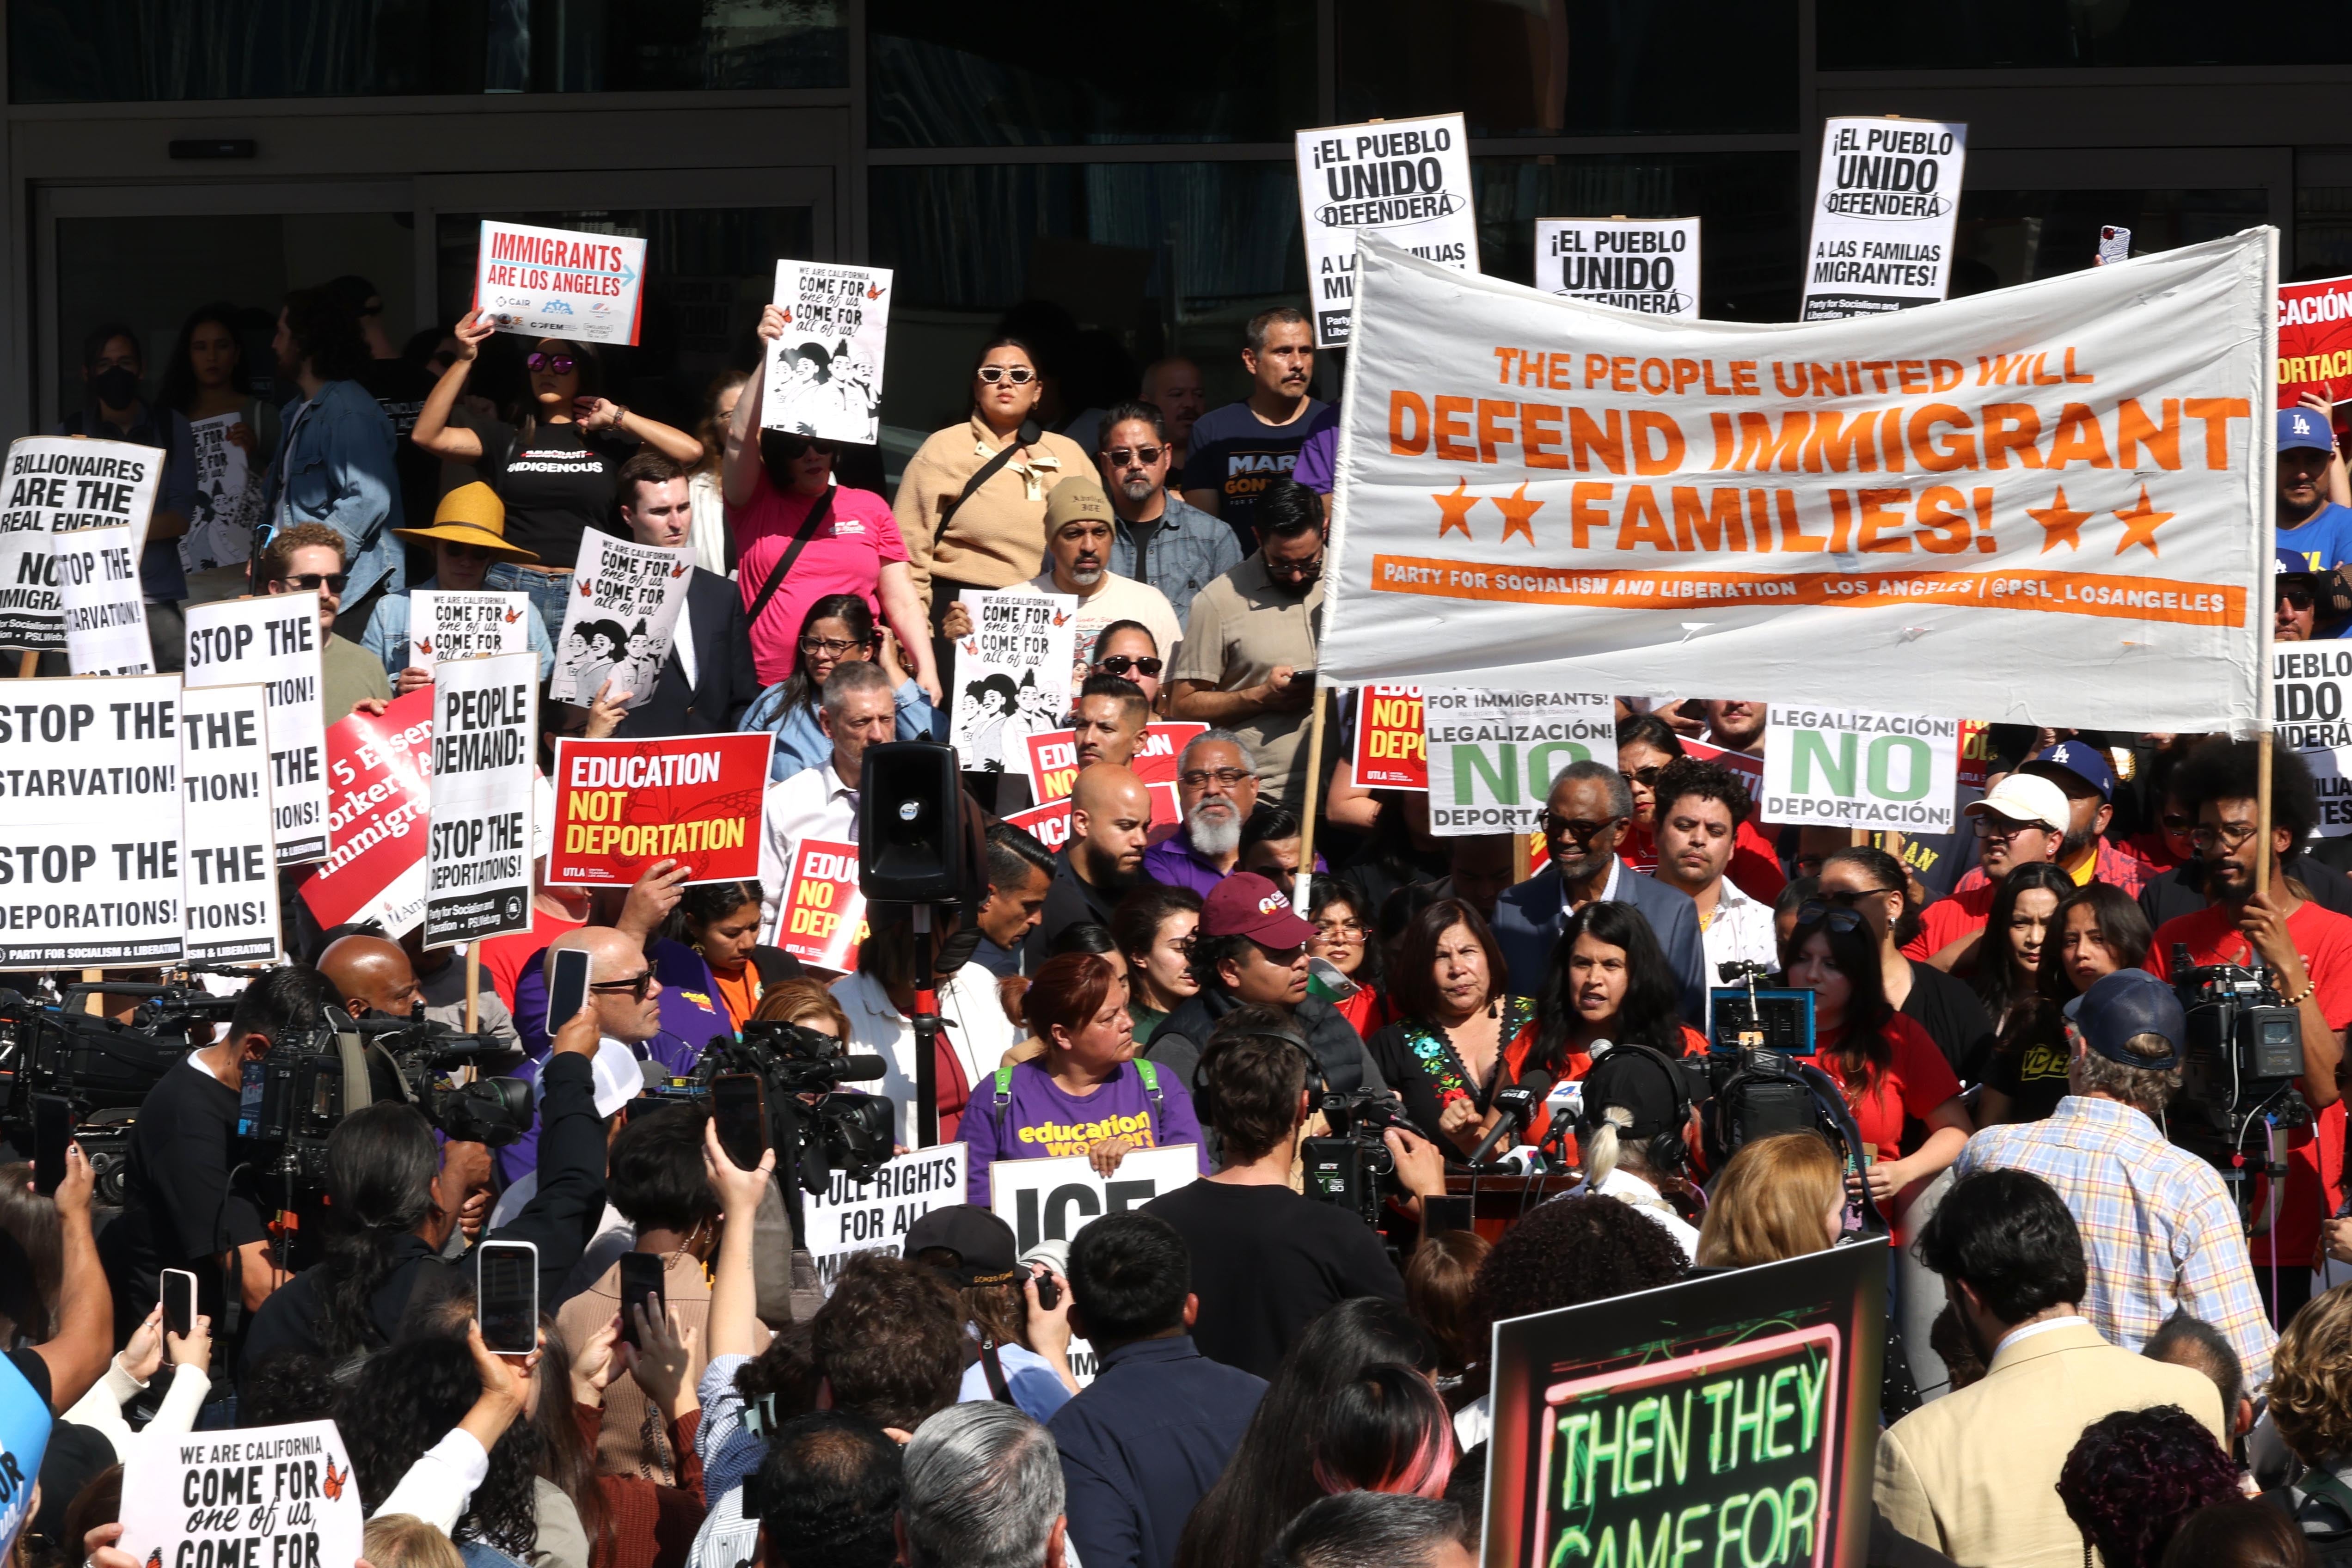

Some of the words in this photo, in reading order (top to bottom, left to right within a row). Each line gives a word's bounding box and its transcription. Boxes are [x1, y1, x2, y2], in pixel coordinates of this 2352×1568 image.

[1313, 140, 1350, 169] ¡EL
[1357, 128, 1451, 159] PUEBLO
[1833, 129, 1860, 156] ¡EL
[1867, 129, 1954, 155] PUEBLO
[1327, 157, 1442, 202] UNIDO
[1838, 155, 1938, 194] UNIDO
[1325, 190, 1453, 227] DEFENDERÁ
[1828, 192, 1939, 216] DEFENDERÁ
[491, 232, 622, 272] IMMIGRANTS
[1552, 230, 1586, 256] ¡EL
[1595, 230, 1685, 253] PUEBLO
[1816, 242, 1824, 258] A
[1830, 241, 1857, 257] LAS
[1862, 242, 1941, 261] FAMILIAS
[828, 270, 870, 280] CALIFORNIA
[1322, 257, 1334, 274] A
[1563, 257, 1674, 291] UNIDO
[1813, 262, 1937, 286] MIGRANTES!
[488, 265, 517, 286] ARE
[521, 269, 548, 290] LOS
[552, 271, 620, 296] ANGELES
[799, 276, 835, 294] COME
[840, 279, 864, 297] FOR
[509, 298, 531, 307] CAIR
[800, 294, 823, 303] one
[827, 293, 843, 307] of
[796, 304, 832, 321] COME
[838, 308, 862, 325] FOR
[796, 319, 815, 332] all
[821, 322, 835, 337] of
[1494, 347, 1571, 390] THE
[1584, 353, 1762, 396] PEOPLE
[1772, 359, 1964, 398] UNITED
[1976, 347, 2094, 386] WILL
[1389, 390, 1686, 476] DEFEND
[1709, 398, 2251, 473] IMMIGRANT
[12, 453, 145, 483] BILLIONAIRES
[8, 478, 68, 508] ARE
[76, 480, 135, 514] THE
[0, 511, 44, 532] REAL
[1572, 481, 1997, 554] FAMILIES!
[602, 539, 614, 549] WE
[616, 543, 630, 553] ARE
[631, 547, 676, 560] CALIFORNIA
[100, 547, 134, 581] THE
[600, 568, 627, 581] one
[630, 572, 646, 587] of
[601, 551, 638, 572] COME
[643, 559, 670, 577] FOR
[595, 580, 633, 602] COME
[638, 587, 664, 604] FOR
[1384, 563, 1441, 585] PARTY
[1449, 570, 1488, 590] FOR
[1495, 574, 1609, 595] SOCIALISM
[1612, 580, 1654, 596] AND
[1661, 580, 1797, 600] LIBERATION
[1823, 580, 1869, 595] LOS
[1877, 579, 1973, 598] ANGELES
[436, 606, 472, 622] COME
[478, 606, 502, 621] FOR
[464, 596, 507, 605] CALIFORNIA
[594, 595, 617, 608] all
[619, 601, 635, 616] of
[1011, 597, 1054, 606] CALIFORNIA
[9, 619, 52, 630] Socialism
[437, 623, 462, 632] one
[466, 621, 480, 634] of
[983, 606, 1022, 622] COME
[1025, 608, 1050, 624] FOR
[984, 622, 1009, 632] one
[1013, 621, 1025, 636] of
[190, 624, 253, 667] STOP
[265, 616, 314, 655] THE
[435, 634, 472, 649] COME
[478, 634, 502, 649] FOR
[436, 648, 457, 660] all
[982, 635, 1021, 652] COME
[1024, 637, 1049, 654] FOR
[983, 649, 1003, 662] all
[1007, 652, 1021, 667] of
[446, 685, 527, 731] PEOPLE
[1428, 695, 1467, 709] FOR
[1475, 693, 1608, 707] IMMIGRANTS!
[0, 704, 94, 743] STOP
[110, 700, 175, 741] THE
[183, 710, 257, 750] THE
[1429, 719, 1612, 742] LEGALIZACIÓN!
[1771, 709, 1954, 738] LEGALIZACIÓN!
[271, 746, 319, 787] THE
[434, 729, 525, 777] DEMAND:
[1790, 729, 1932, 802] NO
[570, 751, 721, 788] EDUCATION
[1367, 771, 1387, 780] UTLA
[1452, 741, 1592, 806] NO
[568, 791, 627, 822] NOT
[1769, 797, 1950, 825] DEPORTACIÓN!
[432, 815, 482, 862] STOP
[488, 812, 523, 851] THE
[565, 817, 746, 856] DEPORTATION
[0, 845, 96, 884] STOP
[112, 840, 178, 882] THE
[191, 845, 266, 885] THE
[563, 867, 585, 877] UTLA
[9, 949, 43, 960] PARTY
[45, 948, 66, 959] FOR
[67, 946, 121, 958] SOCIALISM
[123, 947, 132, 956] &
[133, 943, 182, 956] LIBERATION
[207, 948, 215, 957] &
[217, 943, 270, 957] LIBERATION
[785, 944, 805, 954] UTLA
[1019, 1111, 1151, 1144] education
[877, 1157, 956, 1199] RIGHTS
[841, 1208, 883, 1243] FOR
[1557, 1390, 1692, 1511] THEN
[1703, 1358, 1828, 1474] THEY
[180, 1446, 205, 1464] WE
[210, 1444, 240, 1463] ARE
[246, 1436, 323, 1461] CALIFORNIA
[183, 1465, 263, 1507] COME
[275, 1460, 320, 1502] FOR
[185, 1507, 242, 1533] one
[249, 1495, 279, 1537] of
[287, 1501, 316, 1531] us,
[1719, 1477, 1818, 1568] FOR
[175, 1537, 261, 1568] COME
[274, 1531, 320, 1568] FOR
